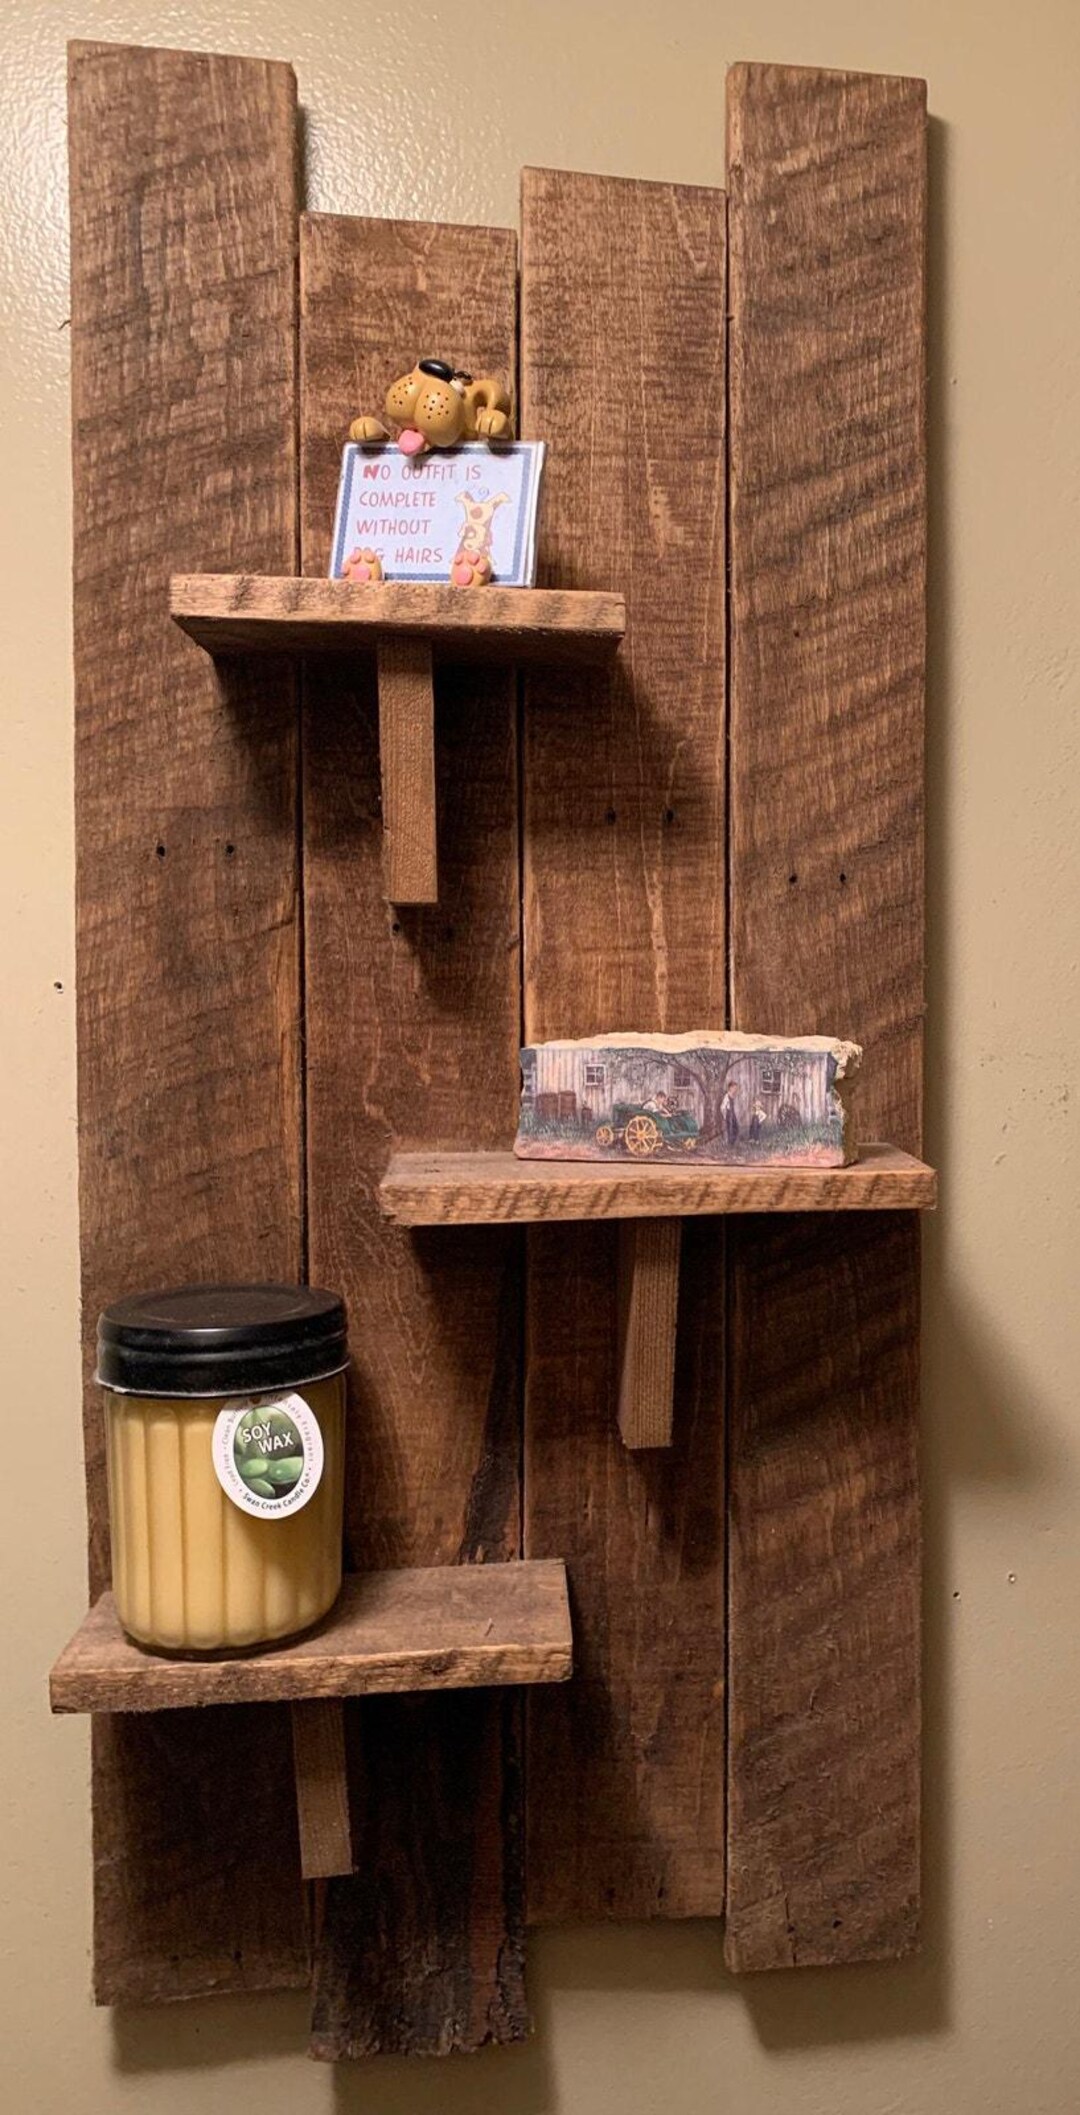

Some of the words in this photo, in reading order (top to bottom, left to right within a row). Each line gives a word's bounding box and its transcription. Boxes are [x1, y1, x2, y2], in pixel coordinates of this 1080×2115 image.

[363, 464, 391, 481] NO
[401, 463, 457, 481] OUTFIT
[466, 464, 482, 481] IS
[359, 491, 436, 508] COMPLETE
[356, 519, 432, 536] WITHOUT
[395, 547, 443, 564] HAIRS
[242, 1421, 272, 1443] SOY
[258, 1432, 294, 1455] WAX
[243, 1492, 260, 1507] Swan
[261, 1502, 282, 1511] Creek
[282, 1489, 305, 1508] Candle
